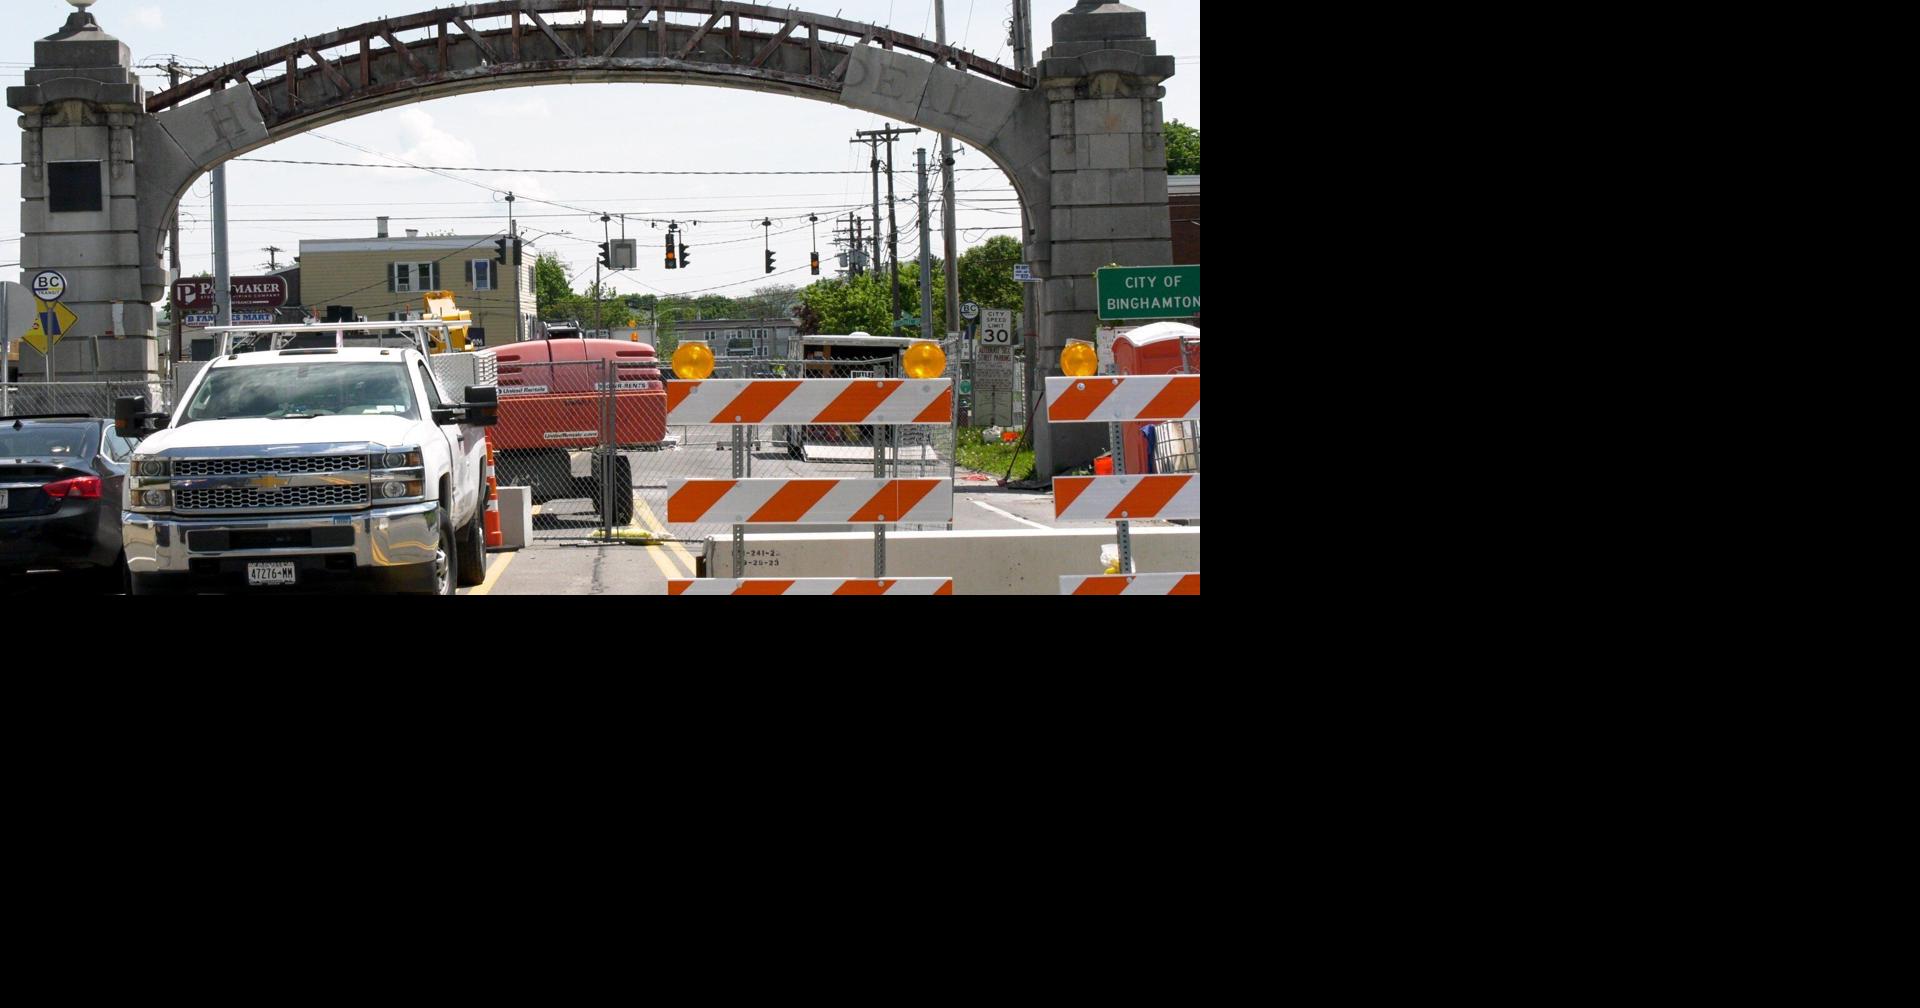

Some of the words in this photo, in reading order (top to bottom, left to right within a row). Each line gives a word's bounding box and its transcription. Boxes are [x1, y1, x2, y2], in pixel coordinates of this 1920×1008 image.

[38, 276, 60, 287] BC
[1125, 276, 1157, 289] CITY
[1164, 275, 1182, 288] OF
[1107, 296, 1200, 310] BINGHAMTON
[984, 329, 1008, 342] 30
